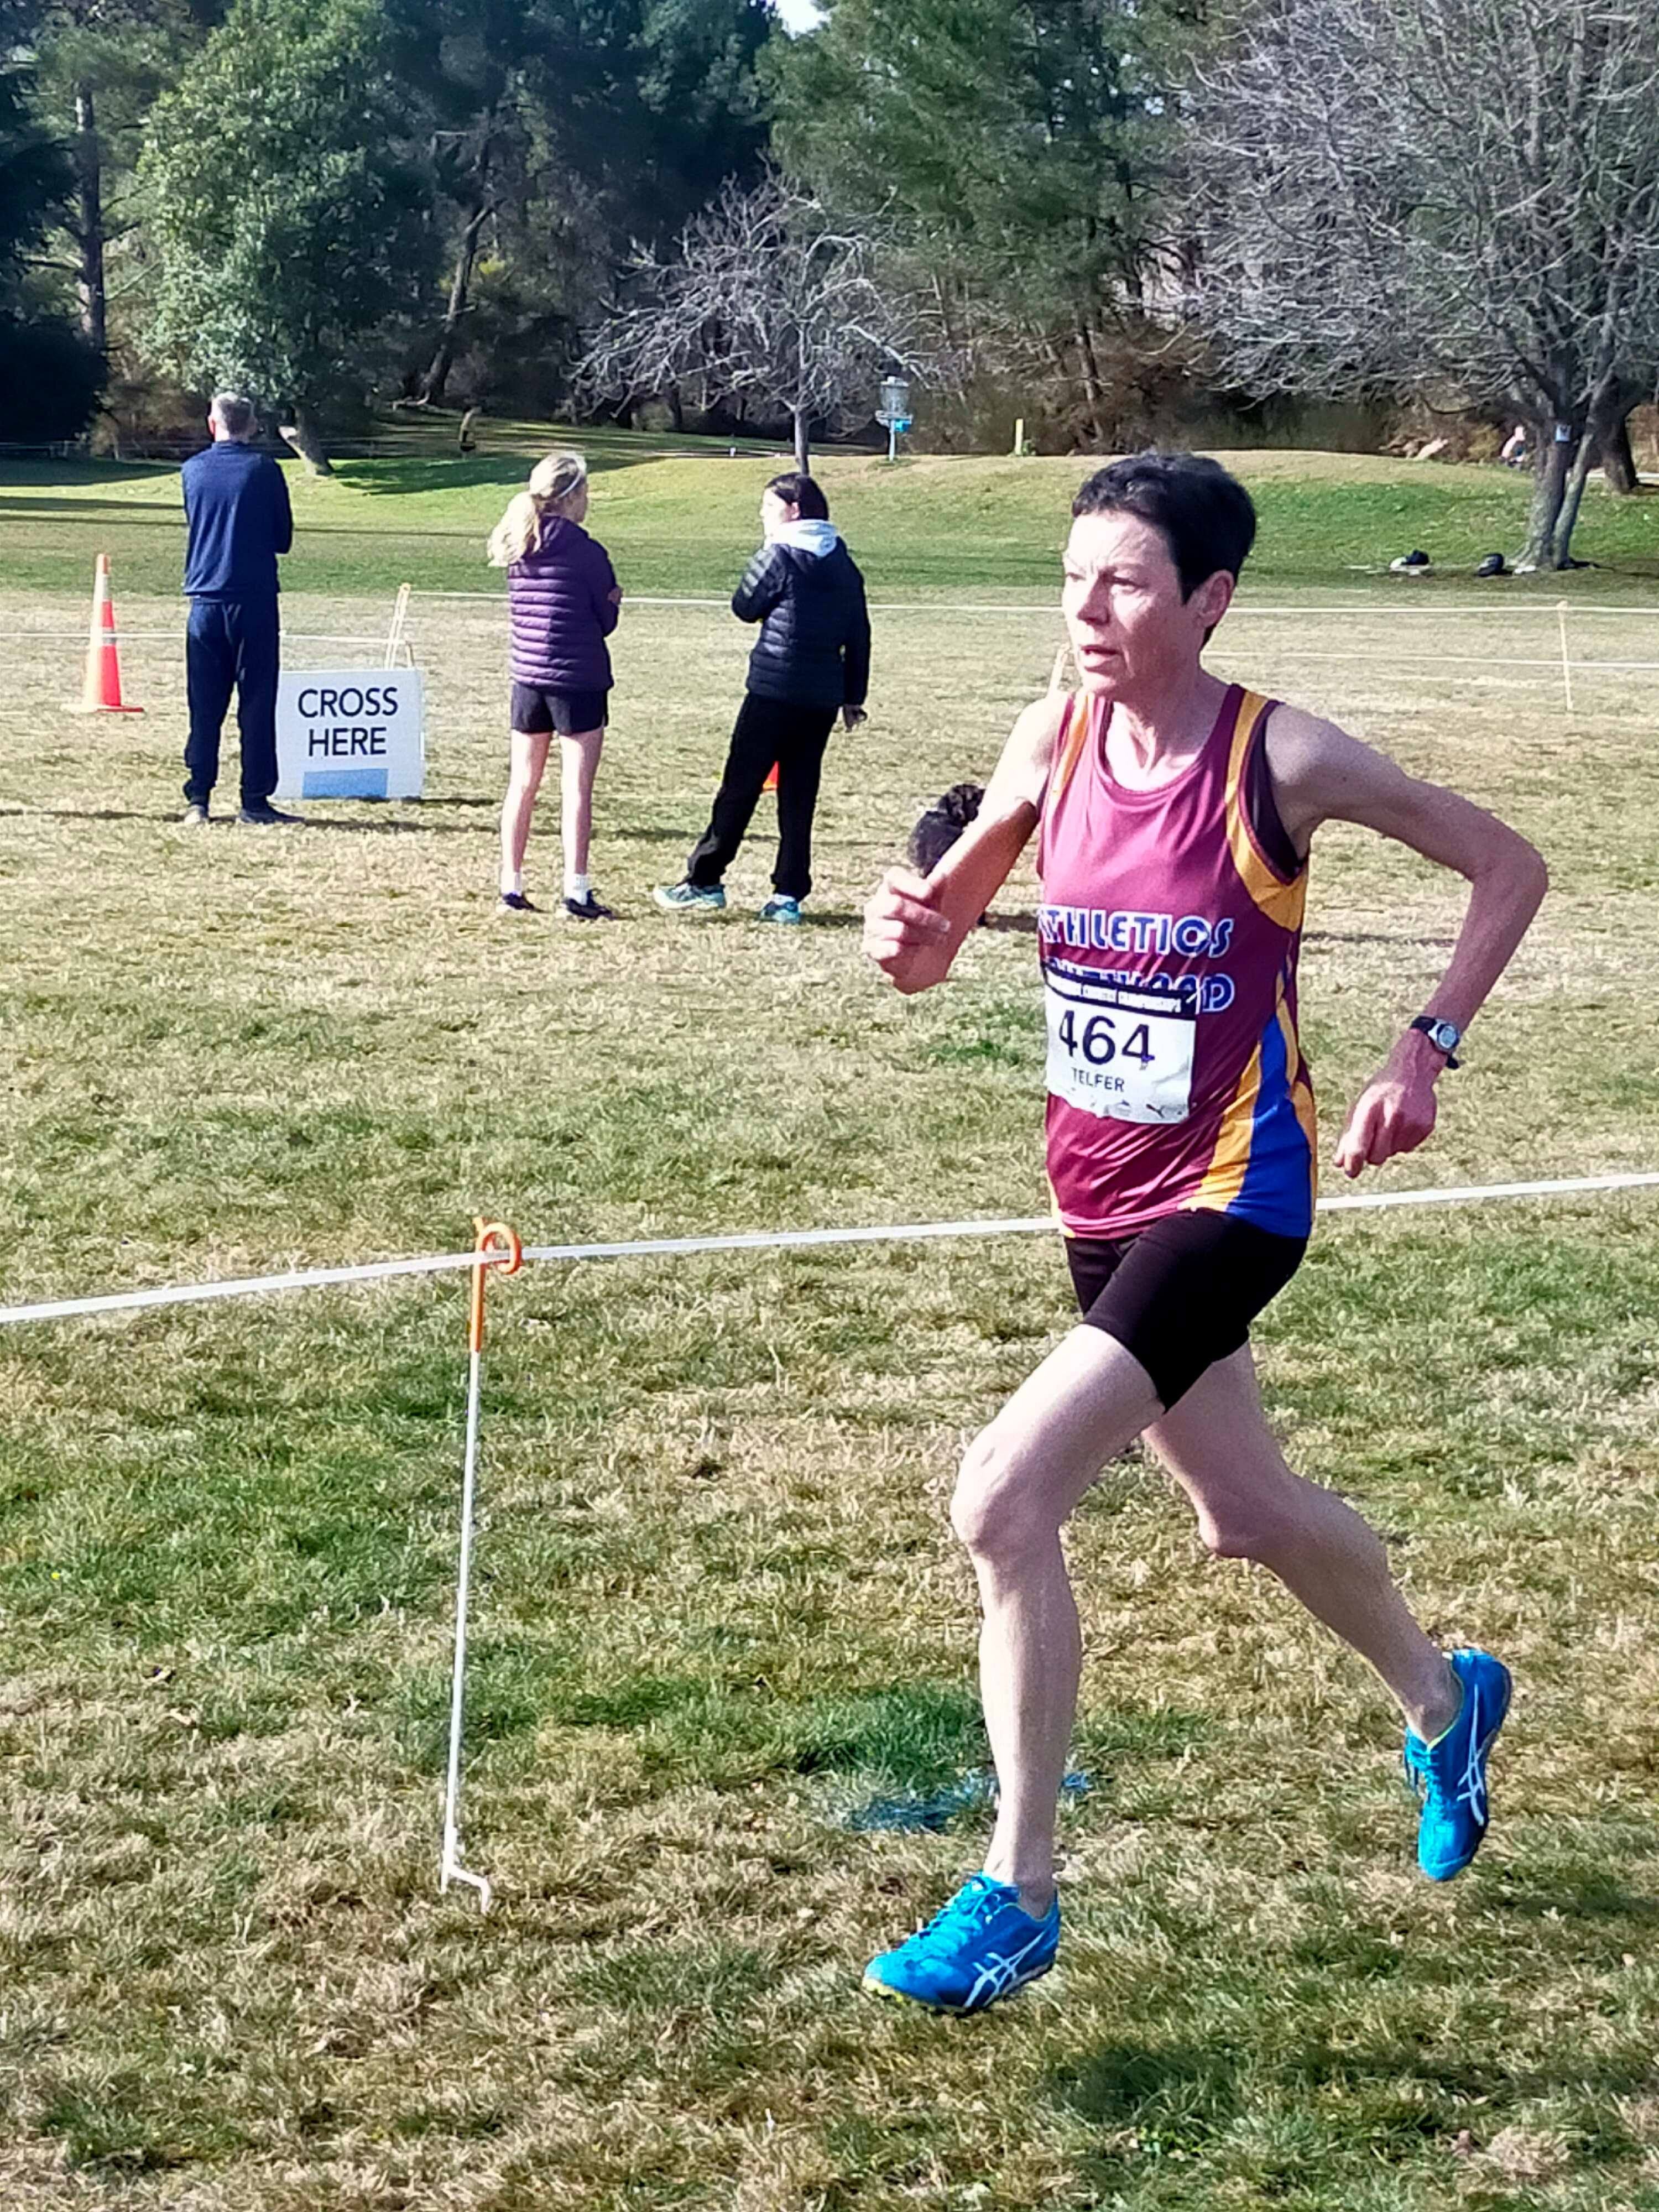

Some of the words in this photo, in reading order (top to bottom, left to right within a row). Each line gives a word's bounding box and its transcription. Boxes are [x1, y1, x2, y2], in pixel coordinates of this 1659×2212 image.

[298, 687, 398, 717] CROSS
[309, 727, 387, 757] HERE
[1059, 1010, 1155, 1065] 464
[1071, 1067, 1125, 1093] TELFER
